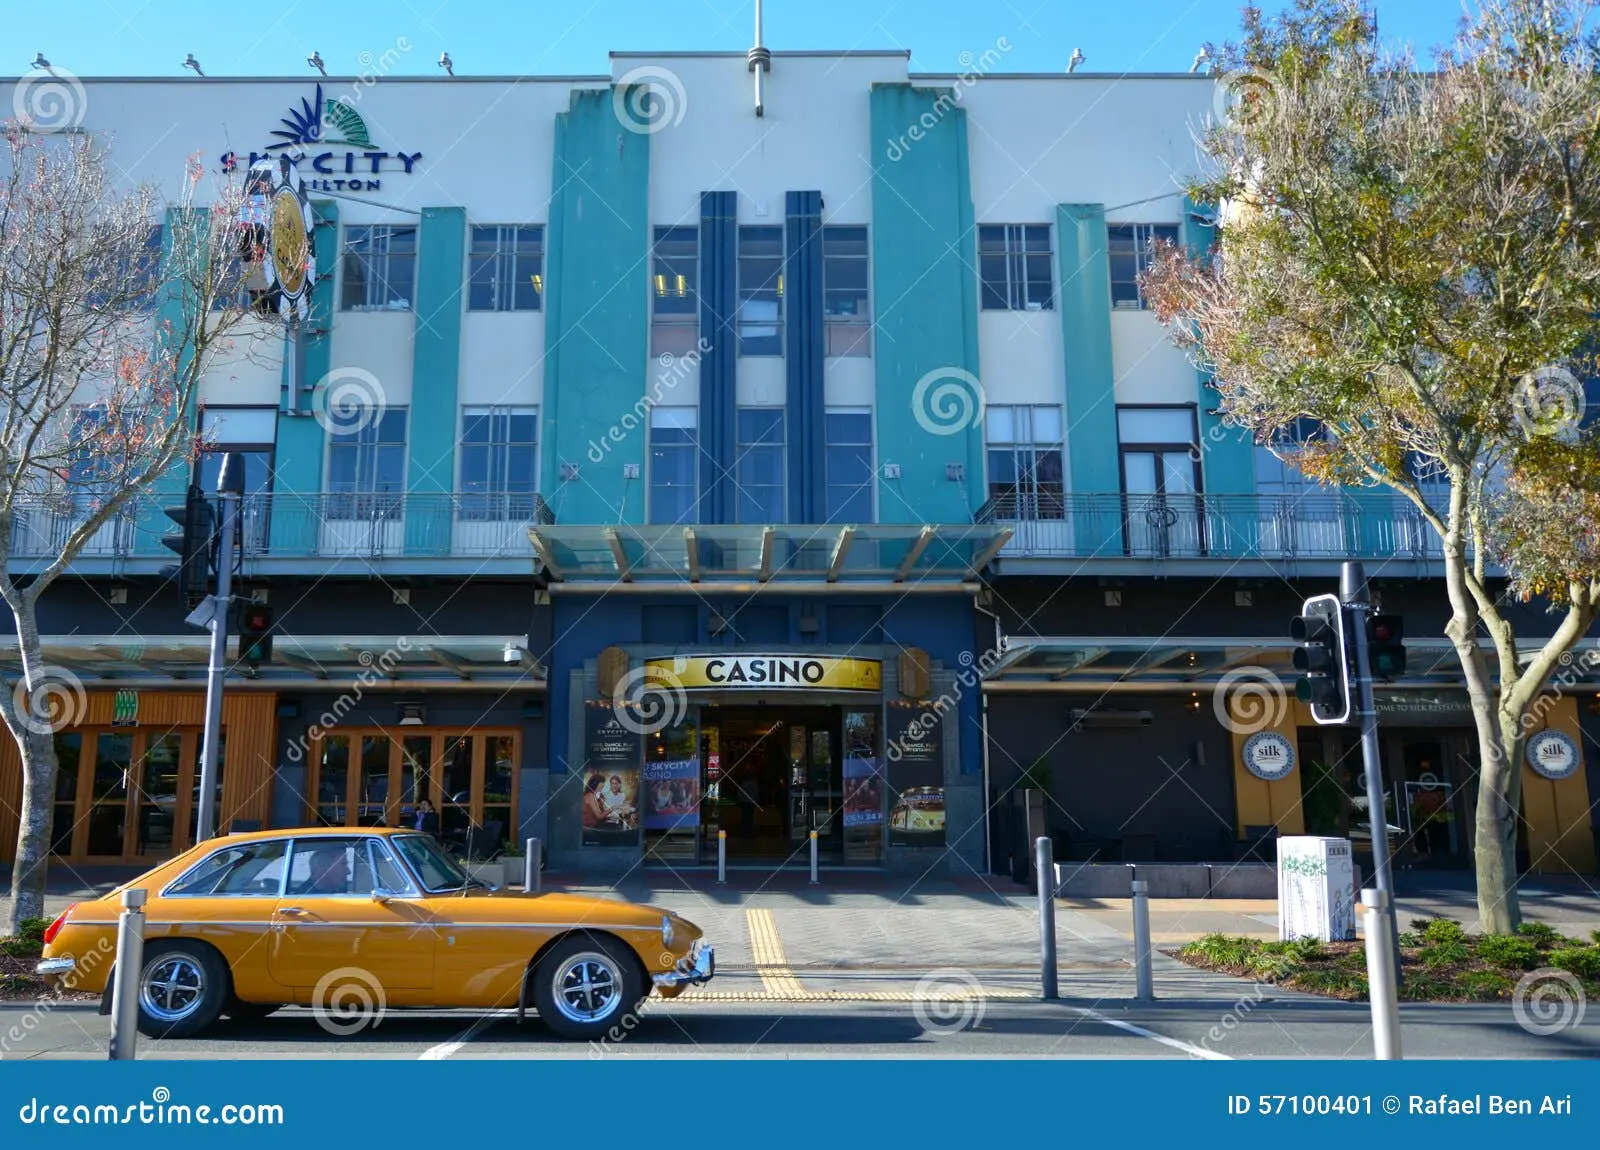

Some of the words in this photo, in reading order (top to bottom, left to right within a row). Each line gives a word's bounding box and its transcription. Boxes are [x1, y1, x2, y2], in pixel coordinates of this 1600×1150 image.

[705, 660, 825, 683] CASINO
[1258, 744, 1281, 757] silk
[1542, 743, 1566, 756] silk
[651, 760, 692, 771] SKYCITY
